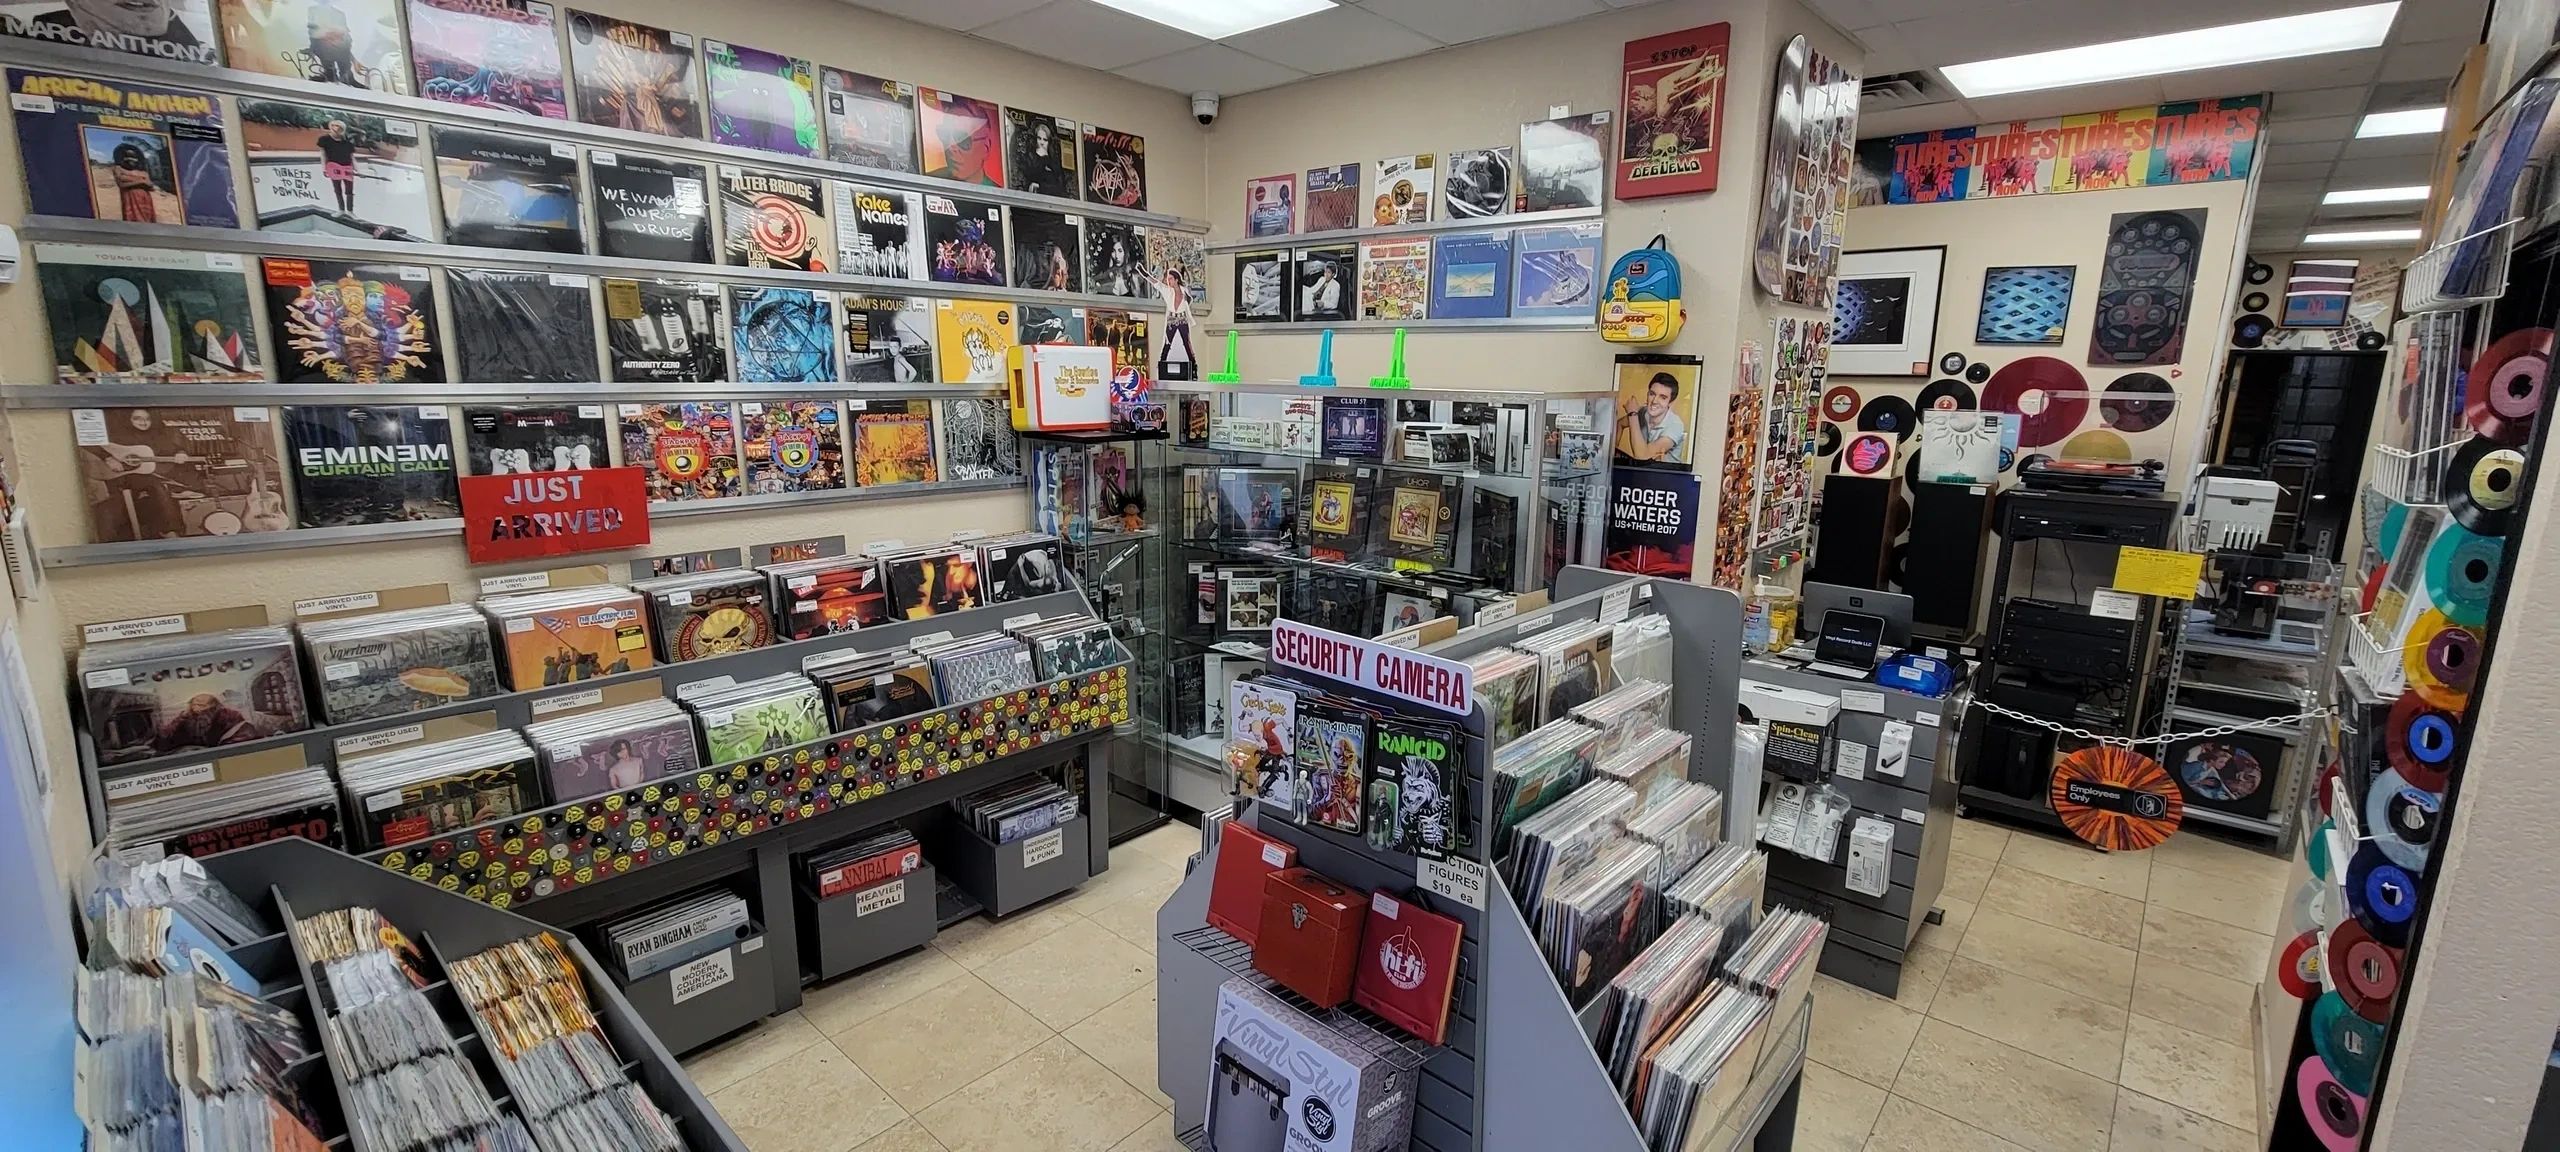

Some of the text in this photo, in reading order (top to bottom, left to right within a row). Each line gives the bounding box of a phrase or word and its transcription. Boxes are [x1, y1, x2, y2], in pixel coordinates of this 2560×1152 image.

[4, 17, 210, 63] MARC ANTHONY
[21, 75, 210, 114] AFRICAN ANTHEM
[53, 101, 78, 112] THE
[123, 110, 163, 122] DREAD
[2198, 99, 2220, 112] THE
[2100, 111, 2119, 124] THE
[2155, 107, 2261, 145] TUBES
[1926, 129, 1944, 140] THE
[2009, 121, 2028, 134] THE
[1974, 129, 2060, 165] TUBES
[2060, 119, 2155, 157] TUBES
[1894, 137, 1974, 173] TUBES
[731, 176, 814, 201] ALTER BRIDGE
[1997, 183, 2021, 196] NOW
[2085, 176, 2111, 189] NOW
[601, 186, 629, 201] WE
[855, 193, 891, 212] Fake
[616, 203, 664, 221] YOUR
[861, 209, 908, 226] Names
[633, 223, 693, 241] DRUGS
[95, 253, 134, 262] YOUNG
[843, 297, 879, 311] ADAM'S
[622, 361, 681, 369] AUTHORITY ZERO
[299, 444, 449, 466] EMINEM
[302, 460, 450, 477] CURTAIN CALL
[504, 475, 584, 505] JUST
[1620, 487, 1677, 507] ROGER
[1614, 502, 1681, 526] WATERS
[491, 507, 624, 542] ARRIVED
[1656, 525, 1679, 535] 2017
[529, 574, 546, 582] USED
[296, 594, 374, 610] JUST ARRIVED USED
[87, 618, 180, 635] JUST ARRIVED USED
[323, 642, 387, 662] Supertramp
[1275, 627, 1466, 711] SECURITY CAMERA
[534, 691, 599, 709] JUST ARRIVED USED
[1299, 714, 1364, 736] IRON MAIDEN
[1771, 721, 1820, 740] Spin-Clean
[339, 726, 419, 748] JUST ARRIVED USED
[368, 738, 392, 747] VINYL
[1379, 732, 1446, 761] RANCID
[108, 767, 209, 791] JUST ARRIVED USED
[146, 781, 175, 791] VINYL
[2069, 793, 2091, 803] Only
[2070, 784, 2121, 800] Employees
[187, 819, 269, 847] ROXY MUSIC
[1025, 832, 1061, 849] UNDERGROUND
[1026, 839, 1059, 856] HARDCORE
[1037, 848, 1056, 861] PUNK
[1445, 856, 1484, 878] CTION
[1428, 864, 1479, 891] FIGURES
[857, 883, 902, 904] HEAVIER
[1432, 879, 1473, 904] $19 ea
[627, 924, 692, 959] RYAN BINGHAM
[682, 963, 719, 982] MODERN
[690, 959, 710, 972] NEW
[676, 971, 716, 991] COUNTRY
[677, 973, 729, 998] AMERICANA
[1367, 1091, 1402, 1119] GROOVE
